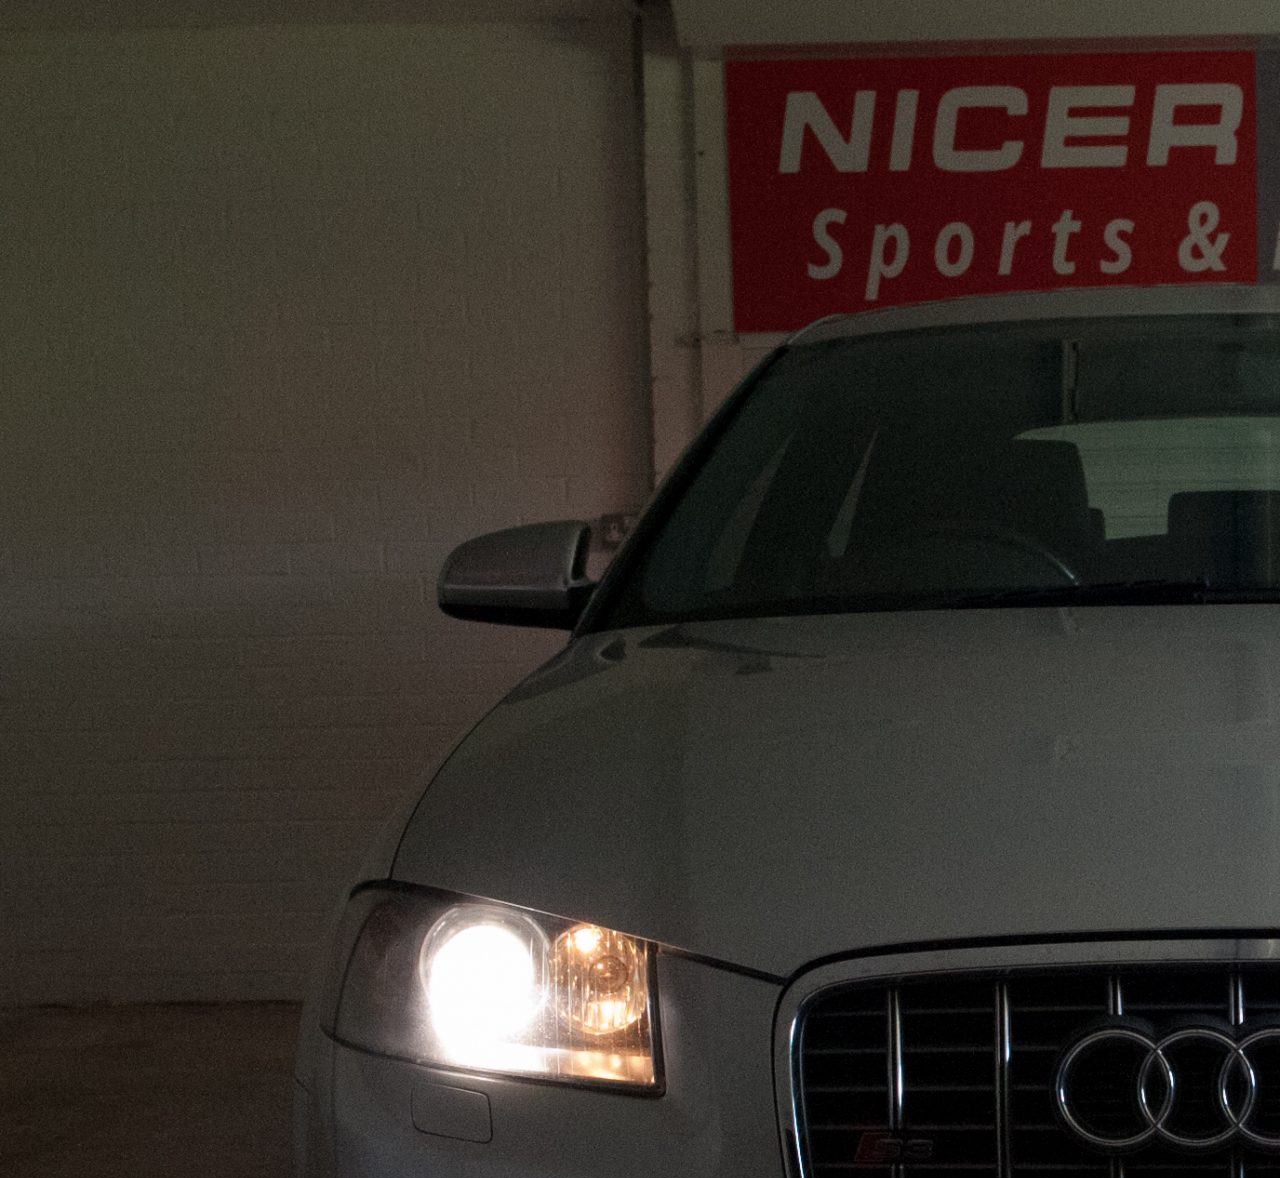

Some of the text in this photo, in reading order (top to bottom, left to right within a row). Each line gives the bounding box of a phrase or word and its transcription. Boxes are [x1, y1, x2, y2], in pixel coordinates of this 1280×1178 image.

[777, 82, 1245, 174] NICER
[806, 207, 1136, 302] Sports
[1177, 200, 1232, 273] &
